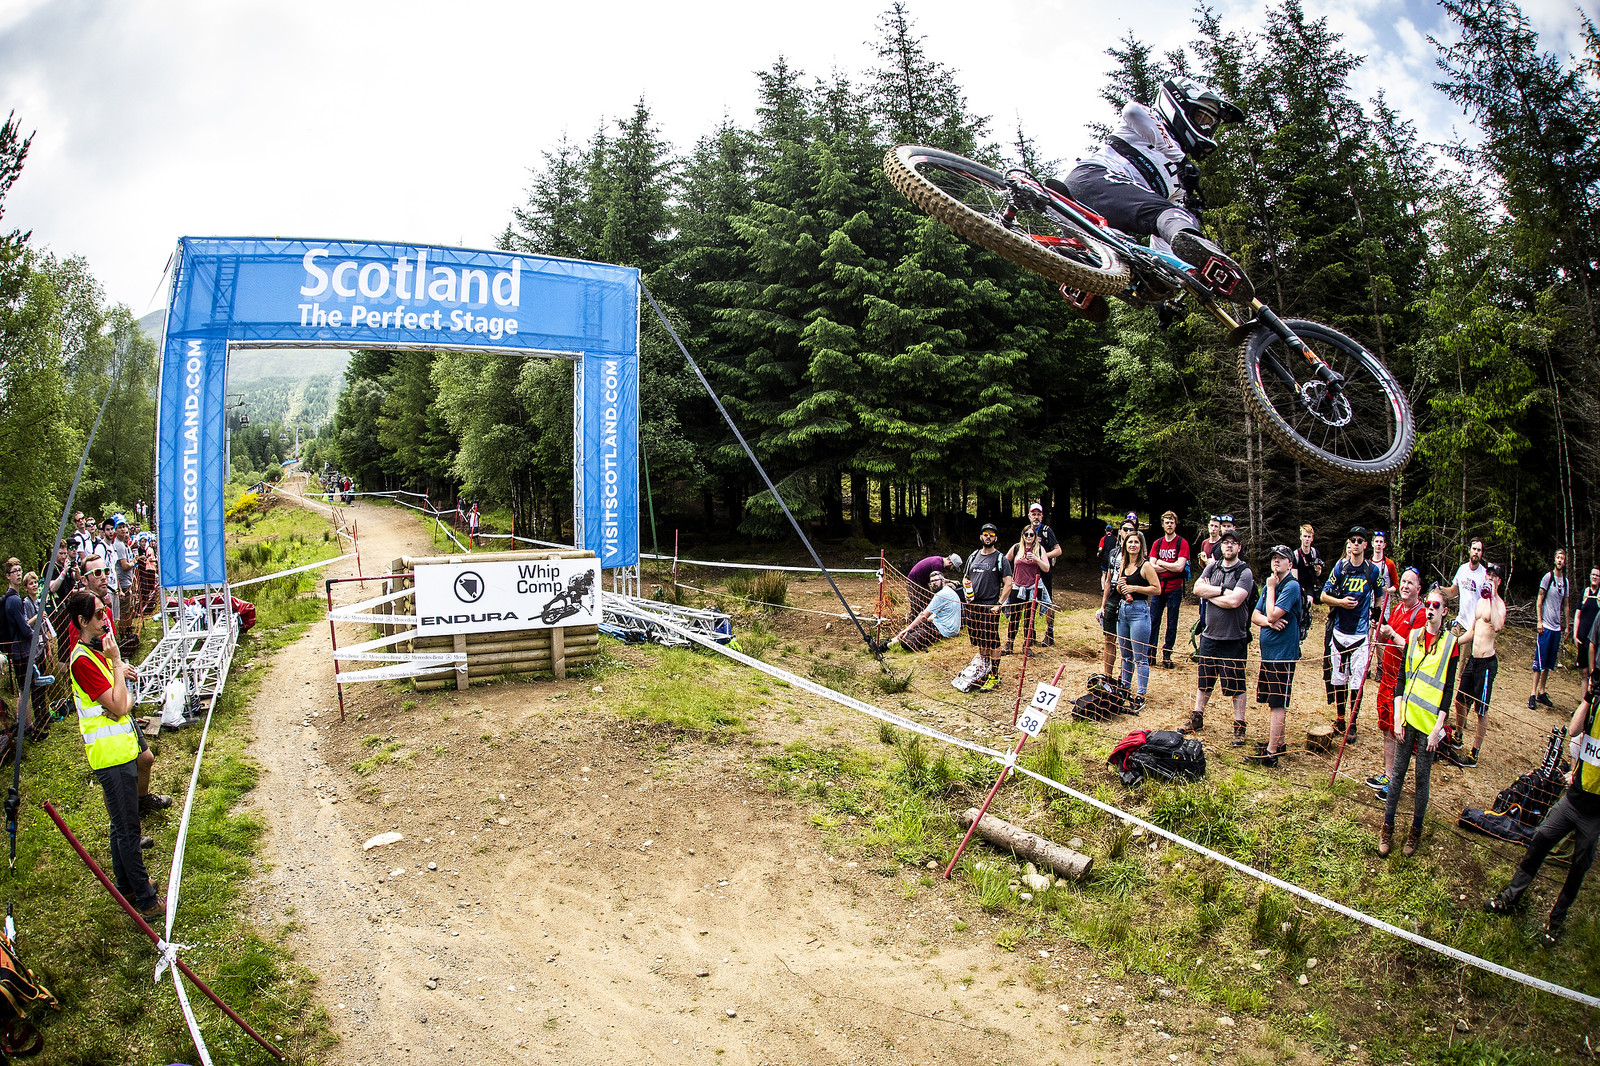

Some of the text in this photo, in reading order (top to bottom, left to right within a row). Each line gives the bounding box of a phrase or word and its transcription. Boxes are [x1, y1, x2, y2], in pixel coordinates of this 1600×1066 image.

[300, 248, 521, 307] Scotland
[298, 303, 518, 340] The Perfect Stage
[183, 340, 202, 573] VISITSCOTLAND.COM
[605, 360, 618, 558] VISITSCOTLAND.COM
[518, 564, 560, 581] Whip
[517, 579, 563, 596] Comp
[421, 611, 519, 626] ENDURA
[1036, 690, 1057, 706] 37
[1021, 715, 1039, 732] 38
